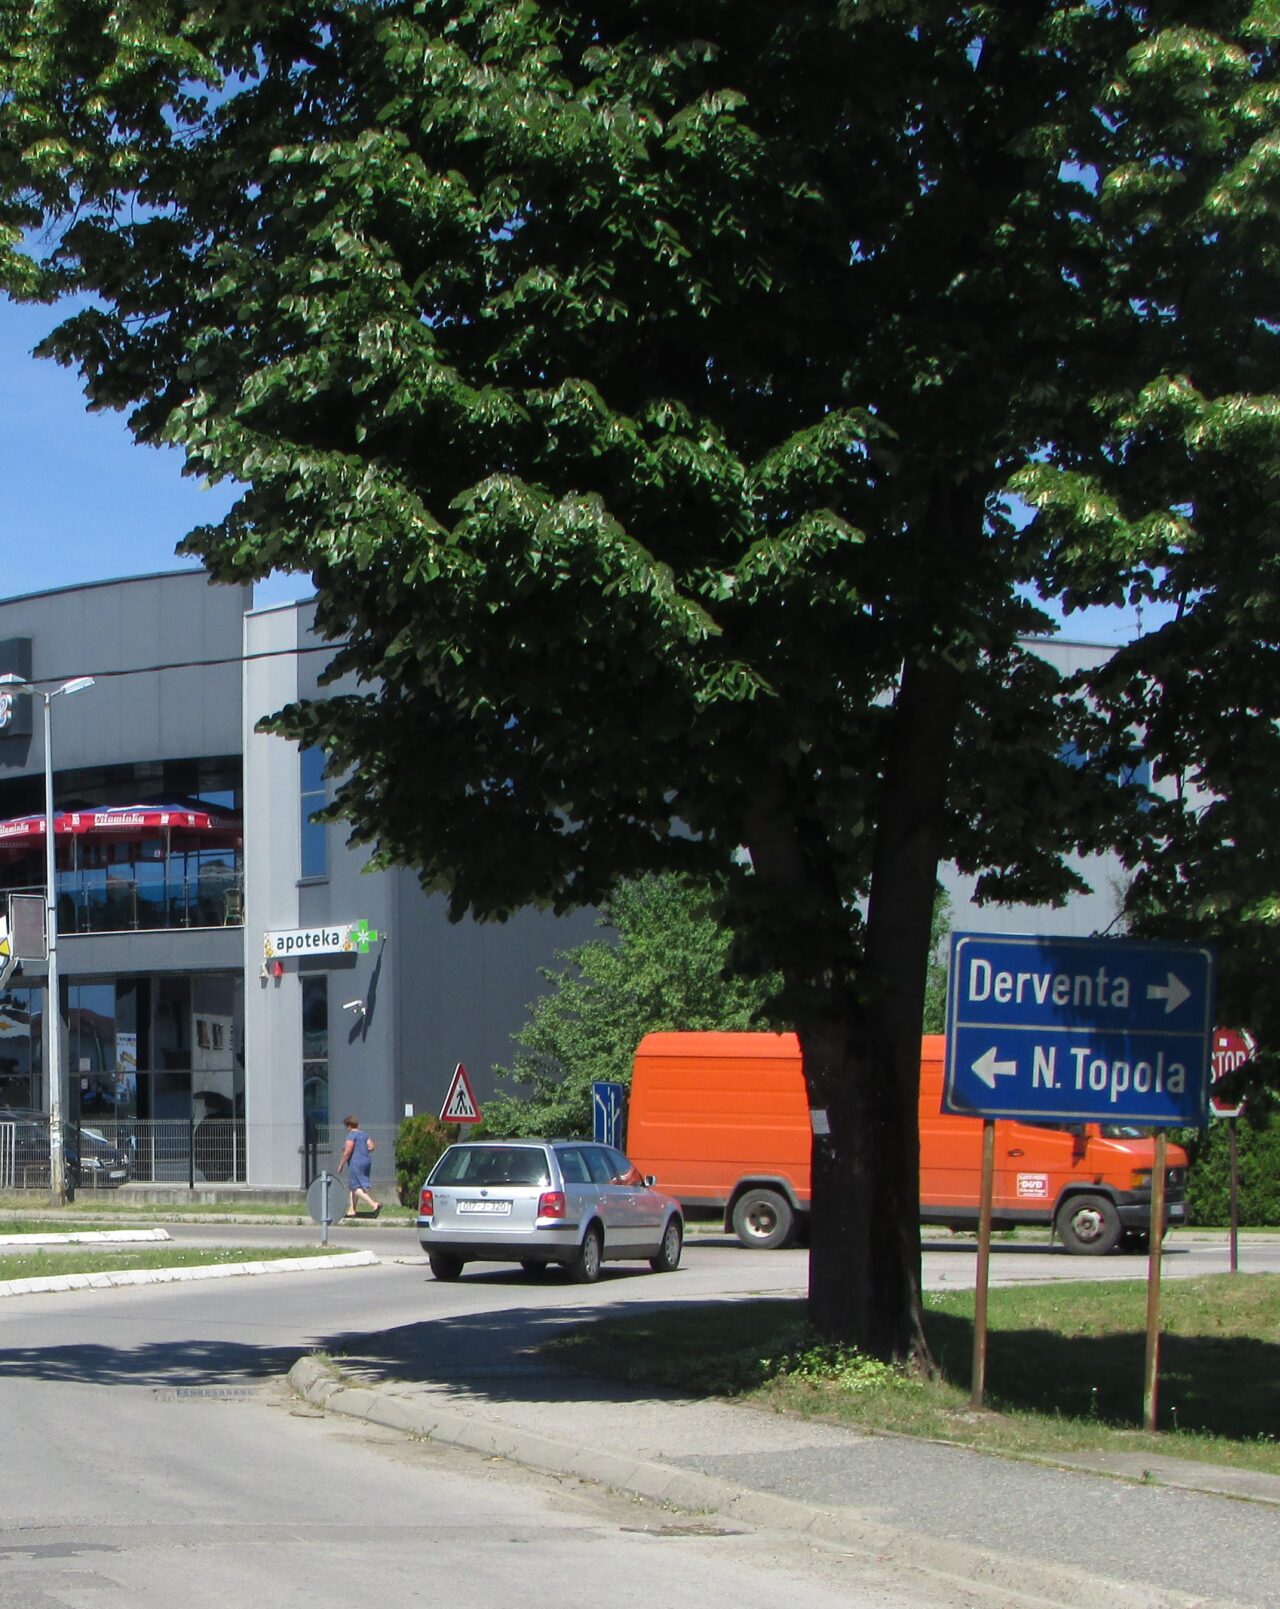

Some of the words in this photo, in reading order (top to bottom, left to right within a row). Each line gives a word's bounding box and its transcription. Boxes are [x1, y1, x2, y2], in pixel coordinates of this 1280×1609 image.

[94, 813, 145, 827] Vitaminka
[277, 929, 340, 953] apoteka
[969, 958, 1130, 1008] Derventa
[1032, 1045, 1061, 1089] N.
[1070, 1047, 1186, 1103] Topola
